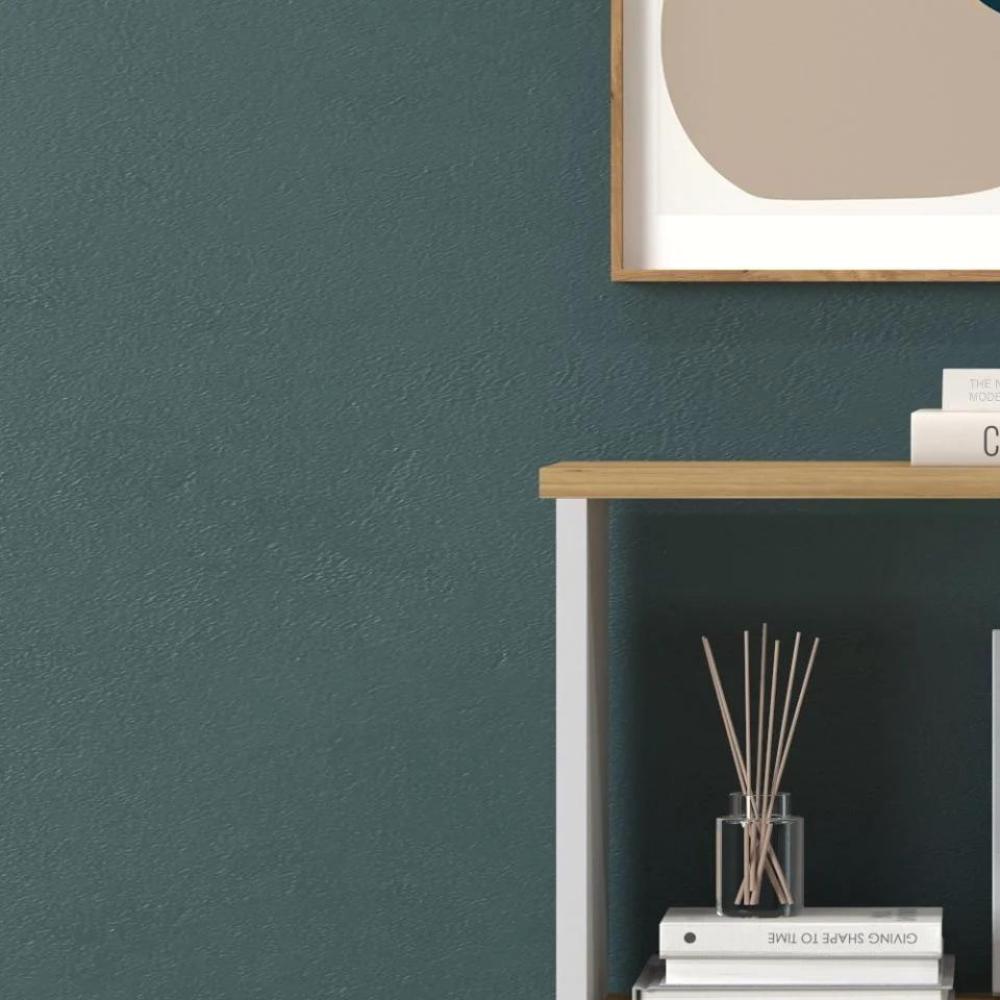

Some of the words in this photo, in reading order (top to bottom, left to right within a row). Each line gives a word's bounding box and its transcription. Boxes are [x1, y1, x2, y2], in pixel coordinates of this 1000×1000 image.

[968, 379, 992, 389] THE
[767, 932, 797, 945] TIME
[800, 932, 818, 945] TO
[822, 932, 864, 945] SHAPE
[868, 932, 919, 945] GIVING
